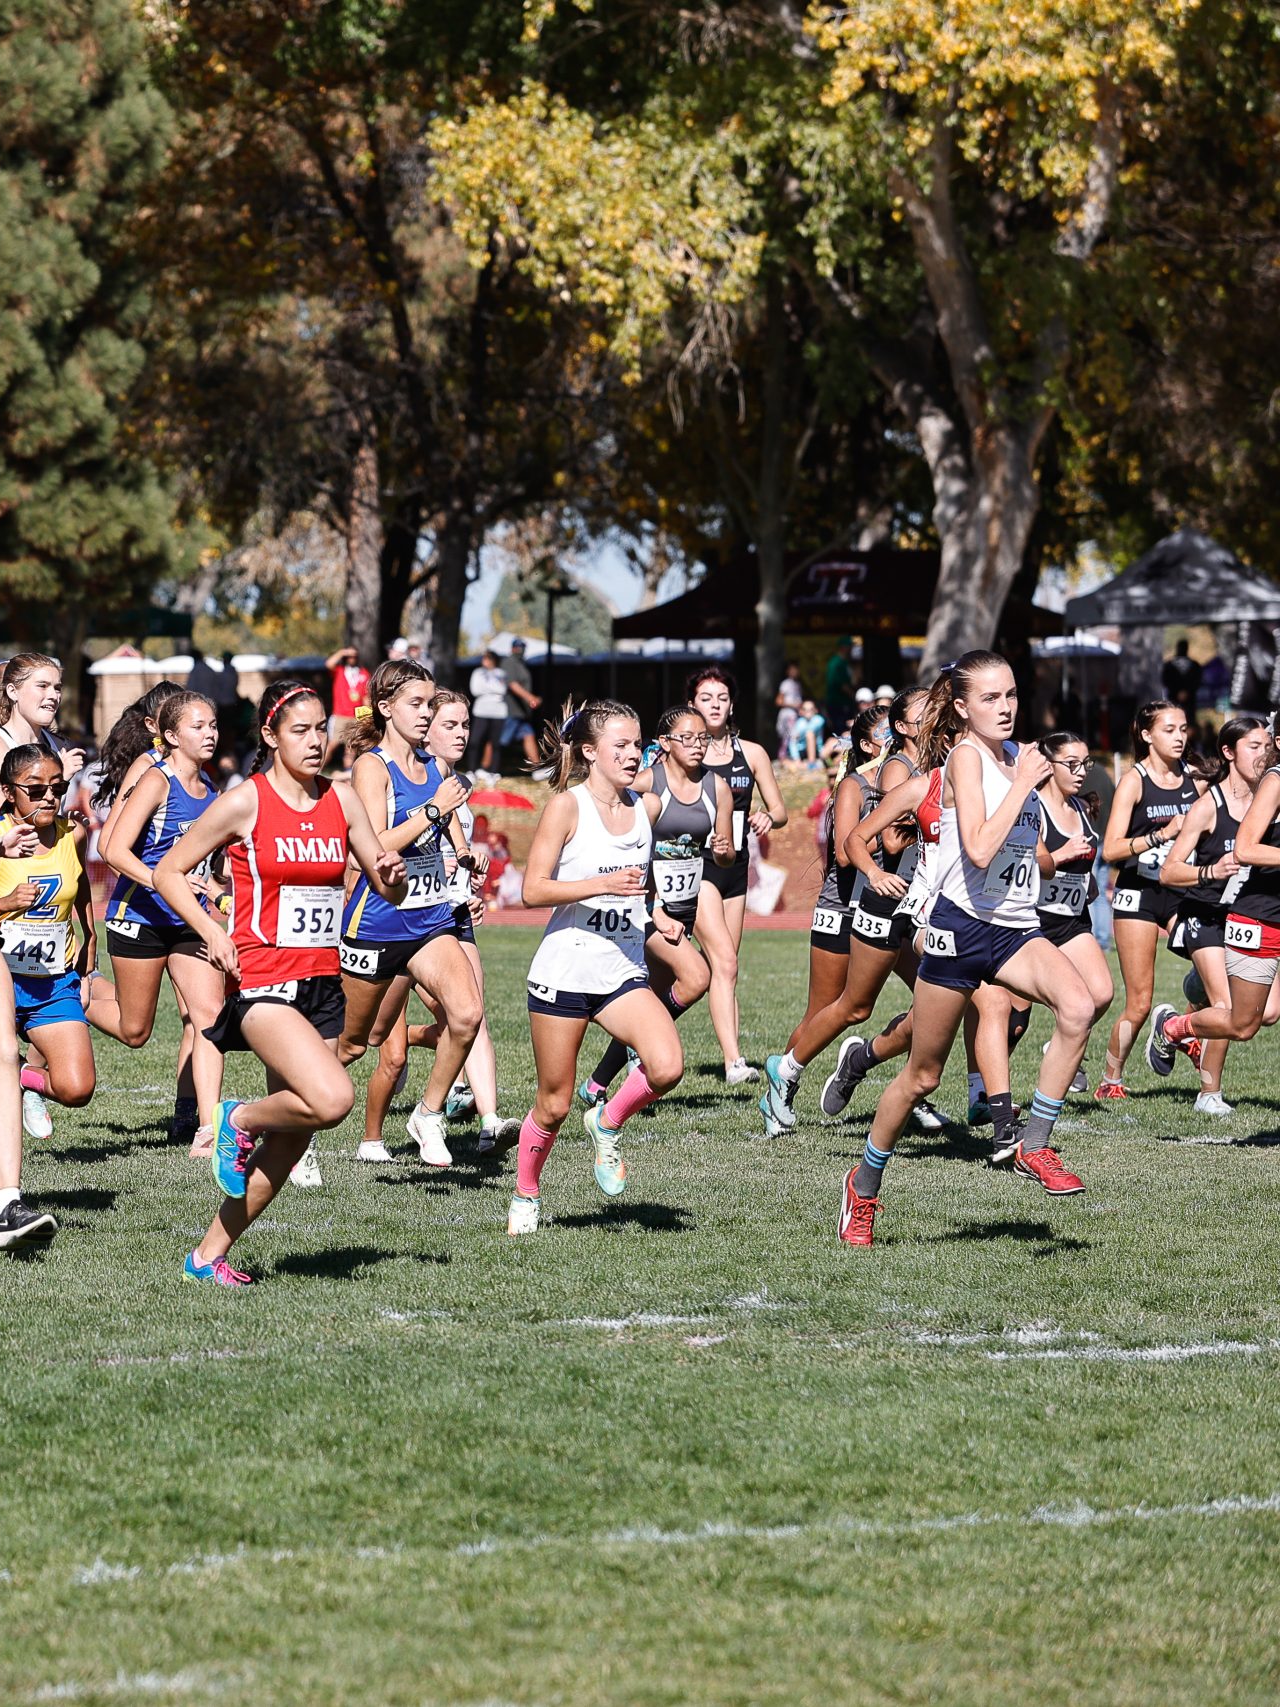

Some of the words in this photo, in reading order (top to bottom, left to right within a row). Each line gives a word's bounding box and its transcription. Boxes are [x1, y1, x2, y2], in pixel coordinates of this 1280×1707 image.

[731, 776, 750, 788] PREP
[1146, 804, 1180, 818] SANDIA
[274, 837, 345, 863] NMMI
[409, 870, 441, 897] 296
[663, 872, 696, 893] 337
[23, 874, 63, 919] Z
[1045, 885, 1081, 907] 370
[292, 907, 334, 934] 352
[586, 908, 633, 933] 405
[856, 914, 883, 935] 335
[1227, 926, 1253, 943] 369
[10, 940, 56, 963] 442
[340, 949, 370, 970] 296
